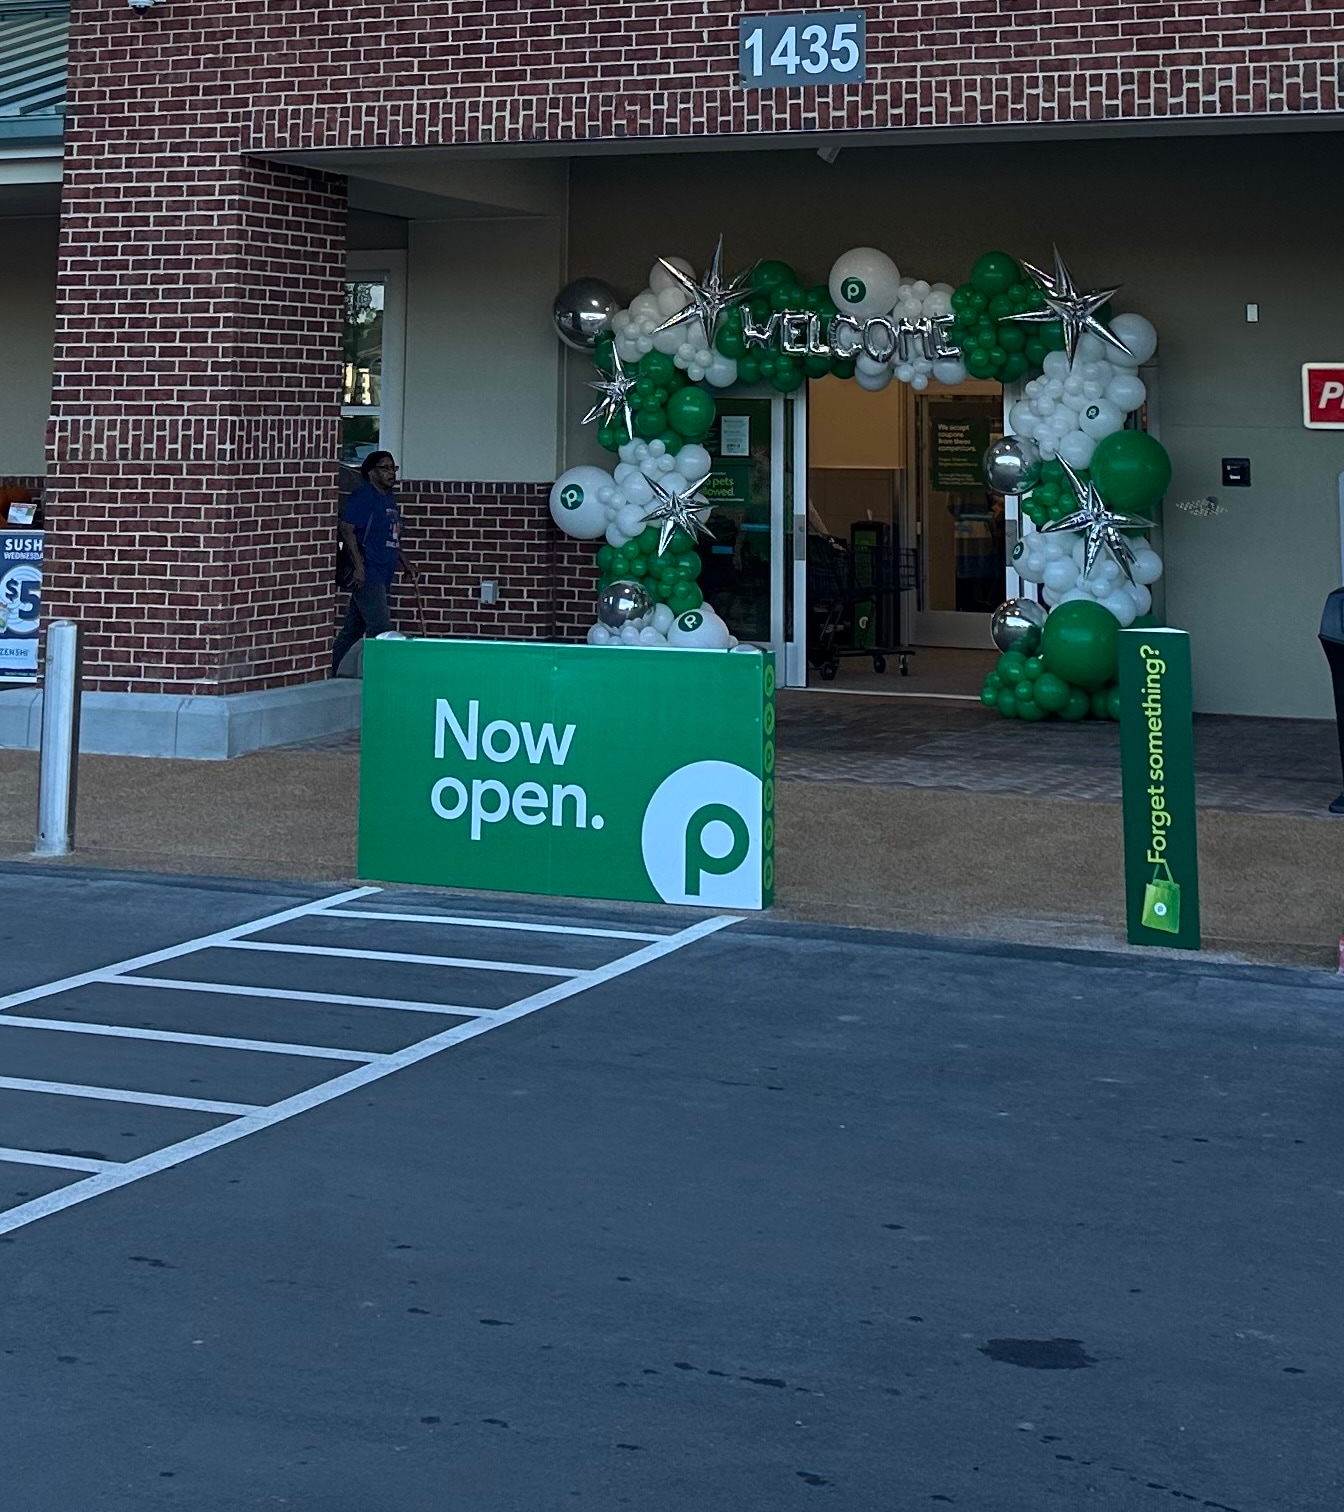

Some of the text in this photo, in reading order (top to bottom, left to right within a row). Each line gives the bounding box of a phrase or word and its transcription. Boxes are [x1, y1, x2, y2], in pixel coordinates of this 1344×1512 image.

[745, 23, 859, 76] 1435
[739, 304, 962, 363] WELCOME
[712, 476, 735, 488] pets
[3, 551, 44, 560] WEDNESDA
[5, 538, 43, 551] SUSH
[434, 698, 577, 766] Now
[1140, 644, 1172, 864] Forget something?
[430, 776, 605, 840] open.
